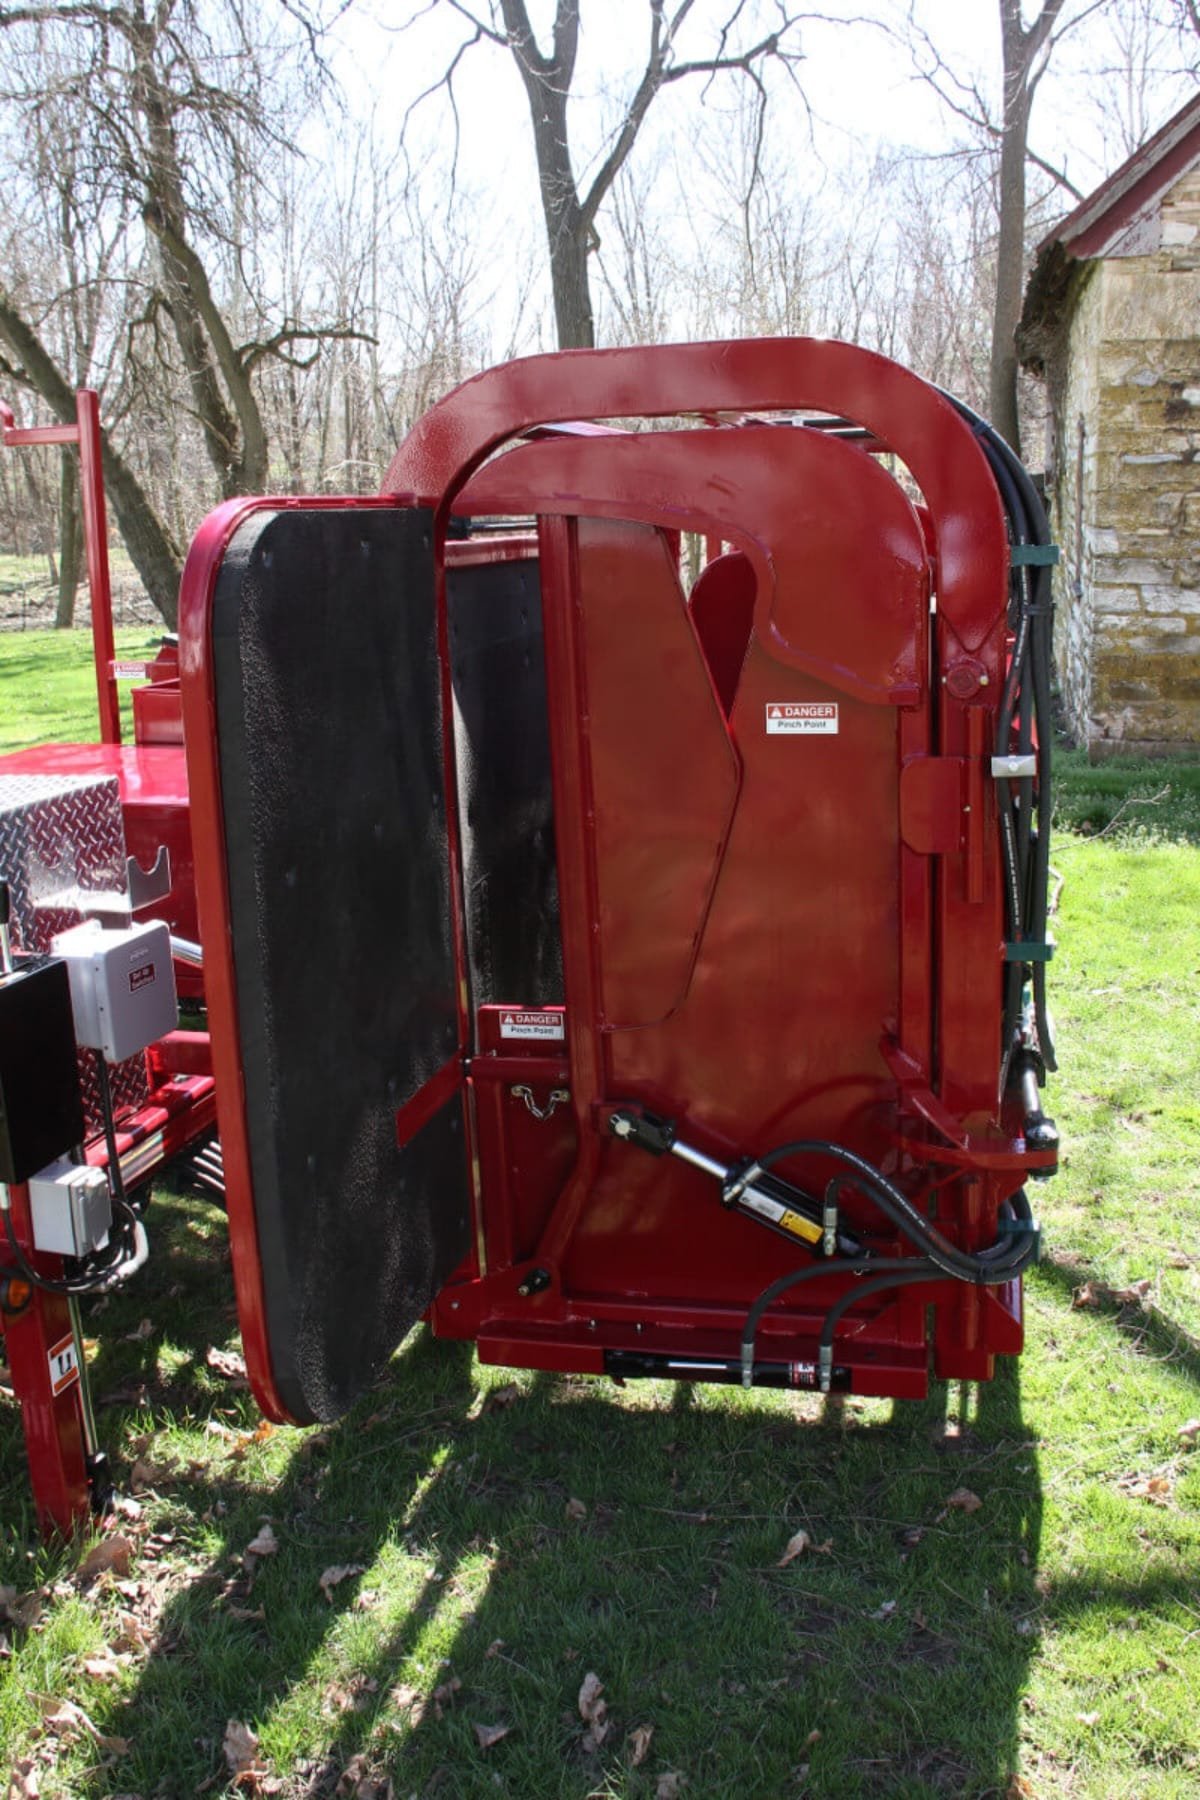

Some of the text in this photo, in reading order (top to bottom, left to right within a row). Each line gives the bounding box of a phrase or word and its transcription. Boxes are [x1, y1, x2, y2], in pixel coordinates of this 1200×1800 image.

[785, 706, 833, 717] DANGER
[777, 721, 827, 729] Pinch Point
[516, 1015, 559, 1024] DANGER
